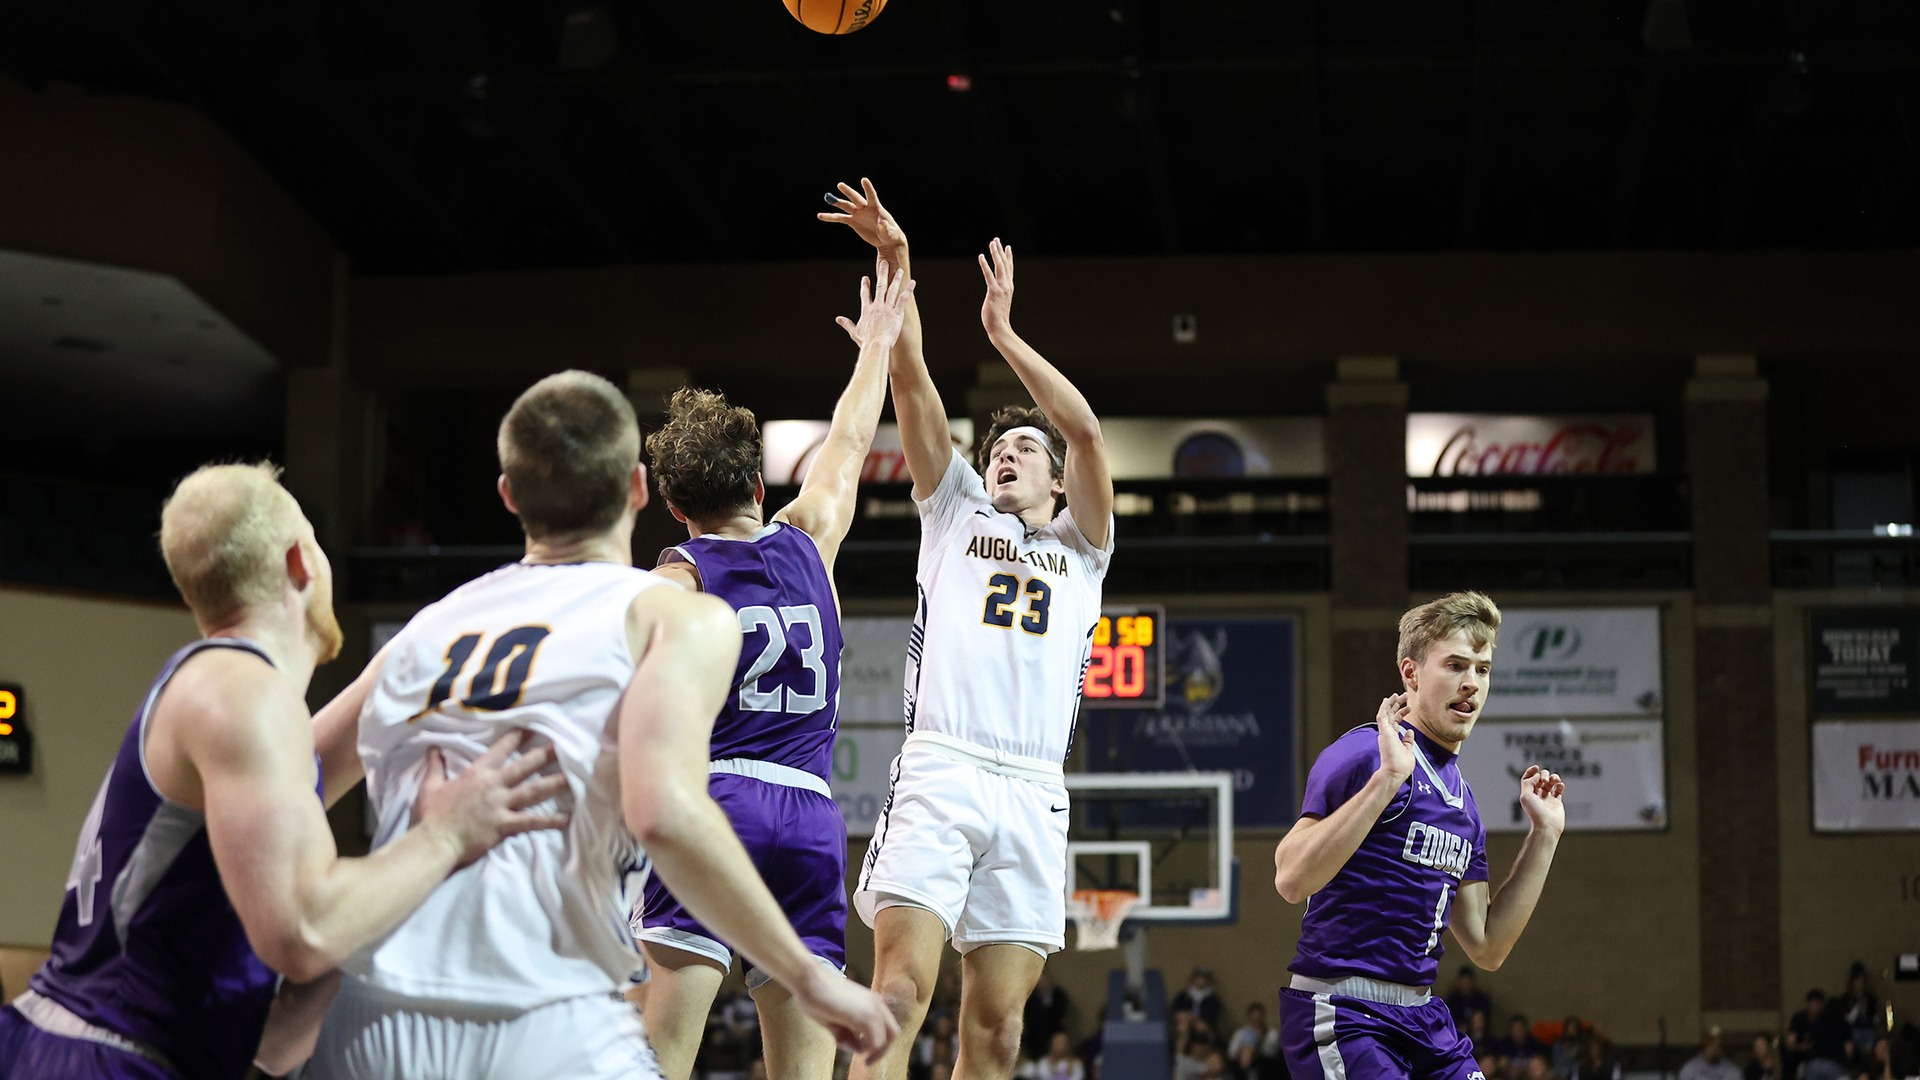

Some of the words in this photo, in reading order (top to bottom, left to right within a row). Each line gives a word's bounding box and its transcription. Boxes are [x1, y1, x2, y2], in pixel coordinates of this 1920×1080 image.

[981, 571, 1052, 637] 23
[407, 622, 553, 724] 10
[736, 604, 828, 715] 23
[1082, 645, 1145, 698] 20
[1425, 882, 1451, 957] 1
